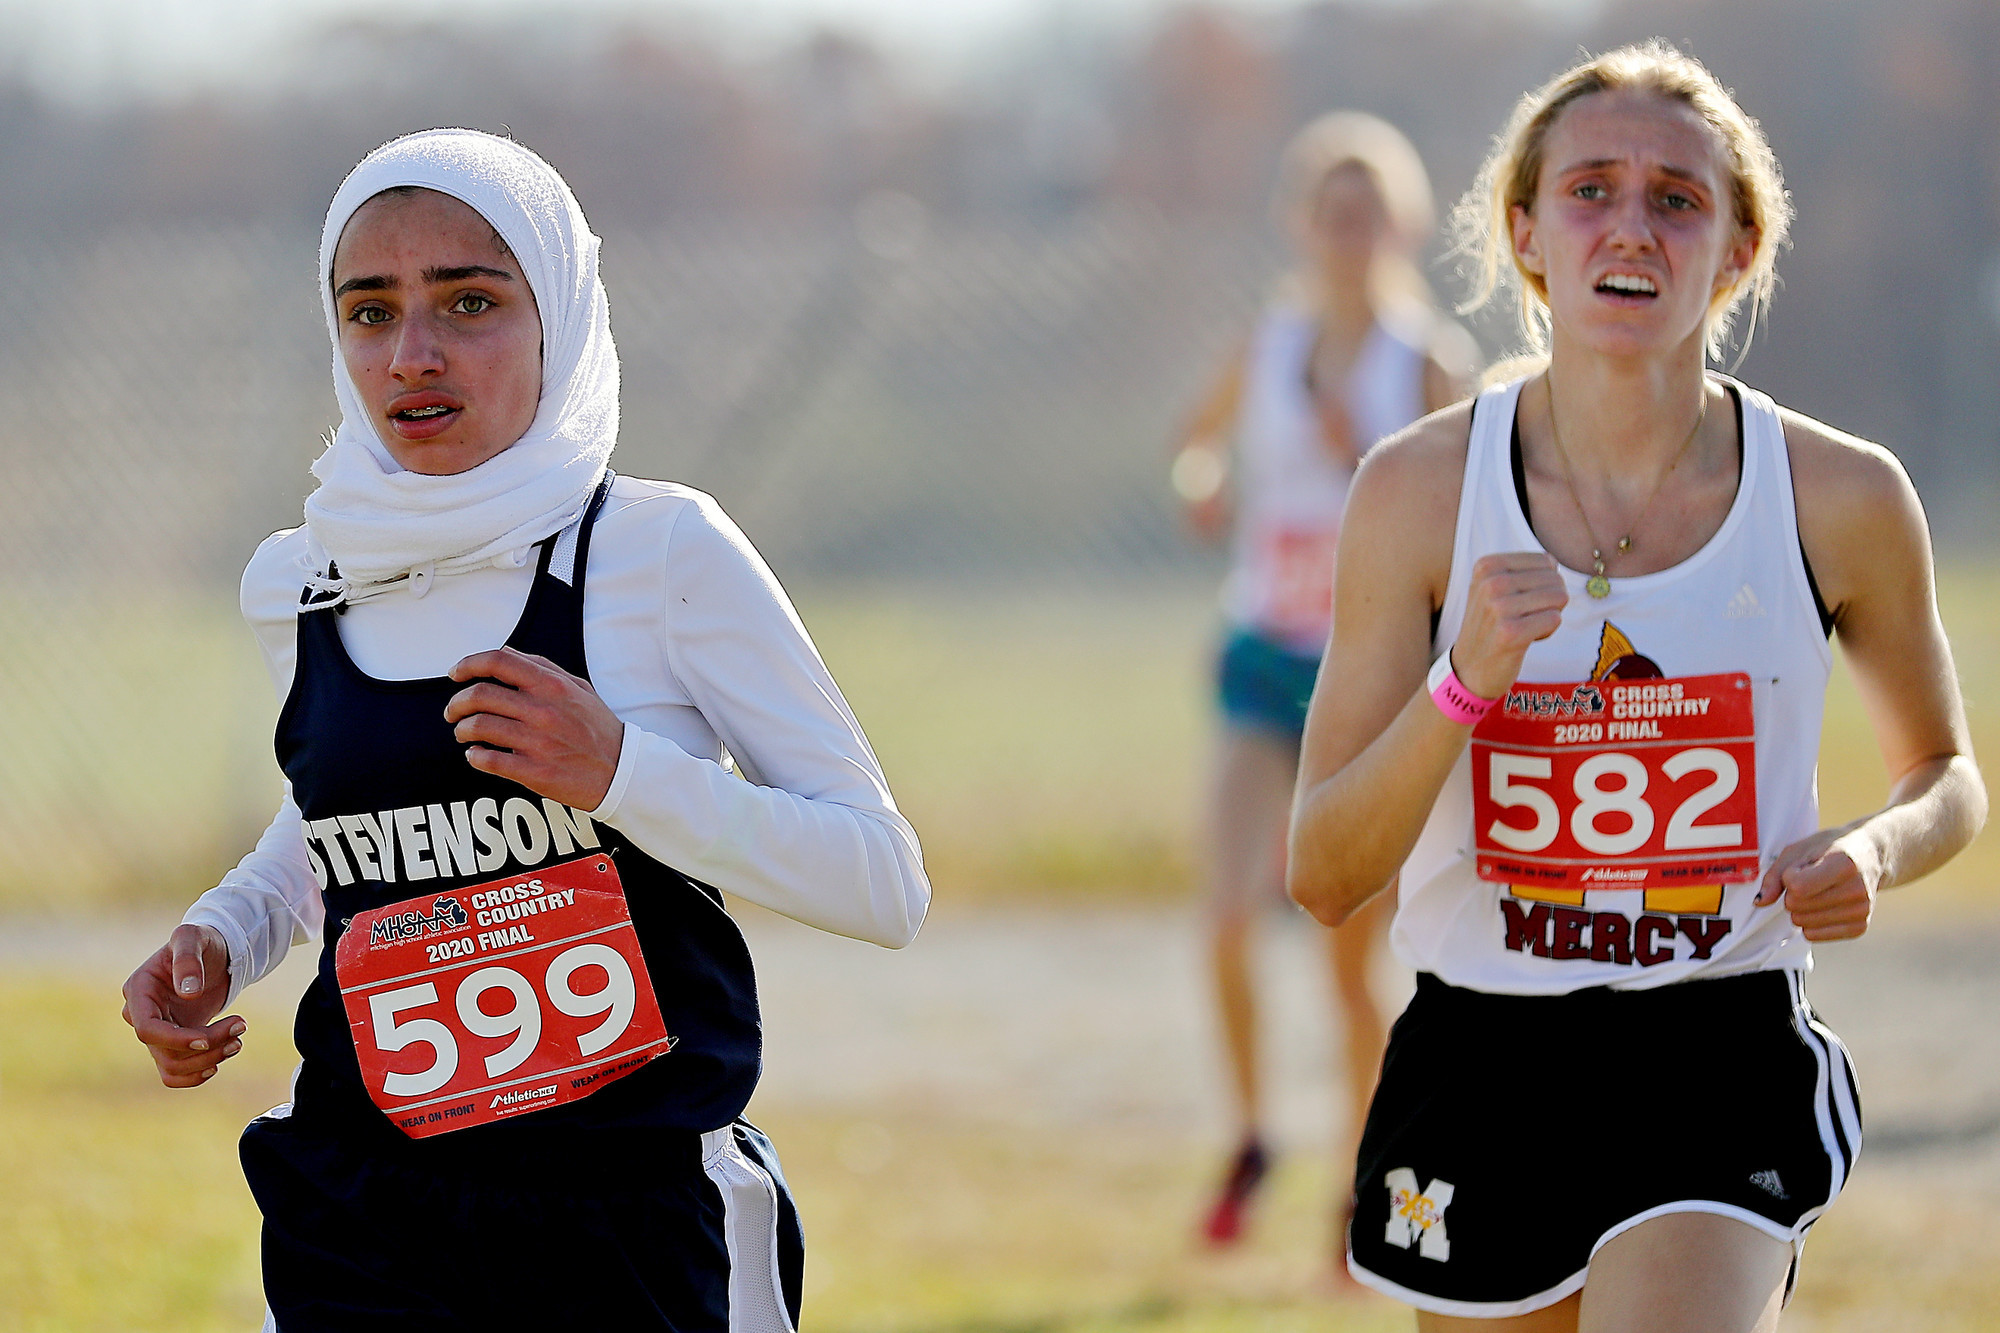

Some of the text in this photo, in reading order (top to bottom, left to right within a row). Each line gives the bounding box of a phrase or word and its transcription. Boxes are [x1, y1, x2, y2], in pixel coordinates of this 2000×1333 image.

[1612, 683, 1684, 703] CROSS
[1613, 698, 1710, 719] COUNTRY
[1554, 720, 1663, 744] 2020 FINAL
[1488, 747, 1743, 855] 582
[301, 797, 601, 891] STEVENSON
[471, 879, 545, 910] CROSS
[476, 888, 575, 927] COUNTRY
[369, 902, 459, 945] MHSAA
[1500, 898, 1732, 968] MERCY
[426, 924, 535, 963] 2020 FINAL
[368, 943, 636, 1097] 599
[571, 1055, 649, 1088] WEAR ON FRONT
[400, 1103, 475, 1128] WEAR ON FRONT
[1384, 1166, 1455, 1263] M
